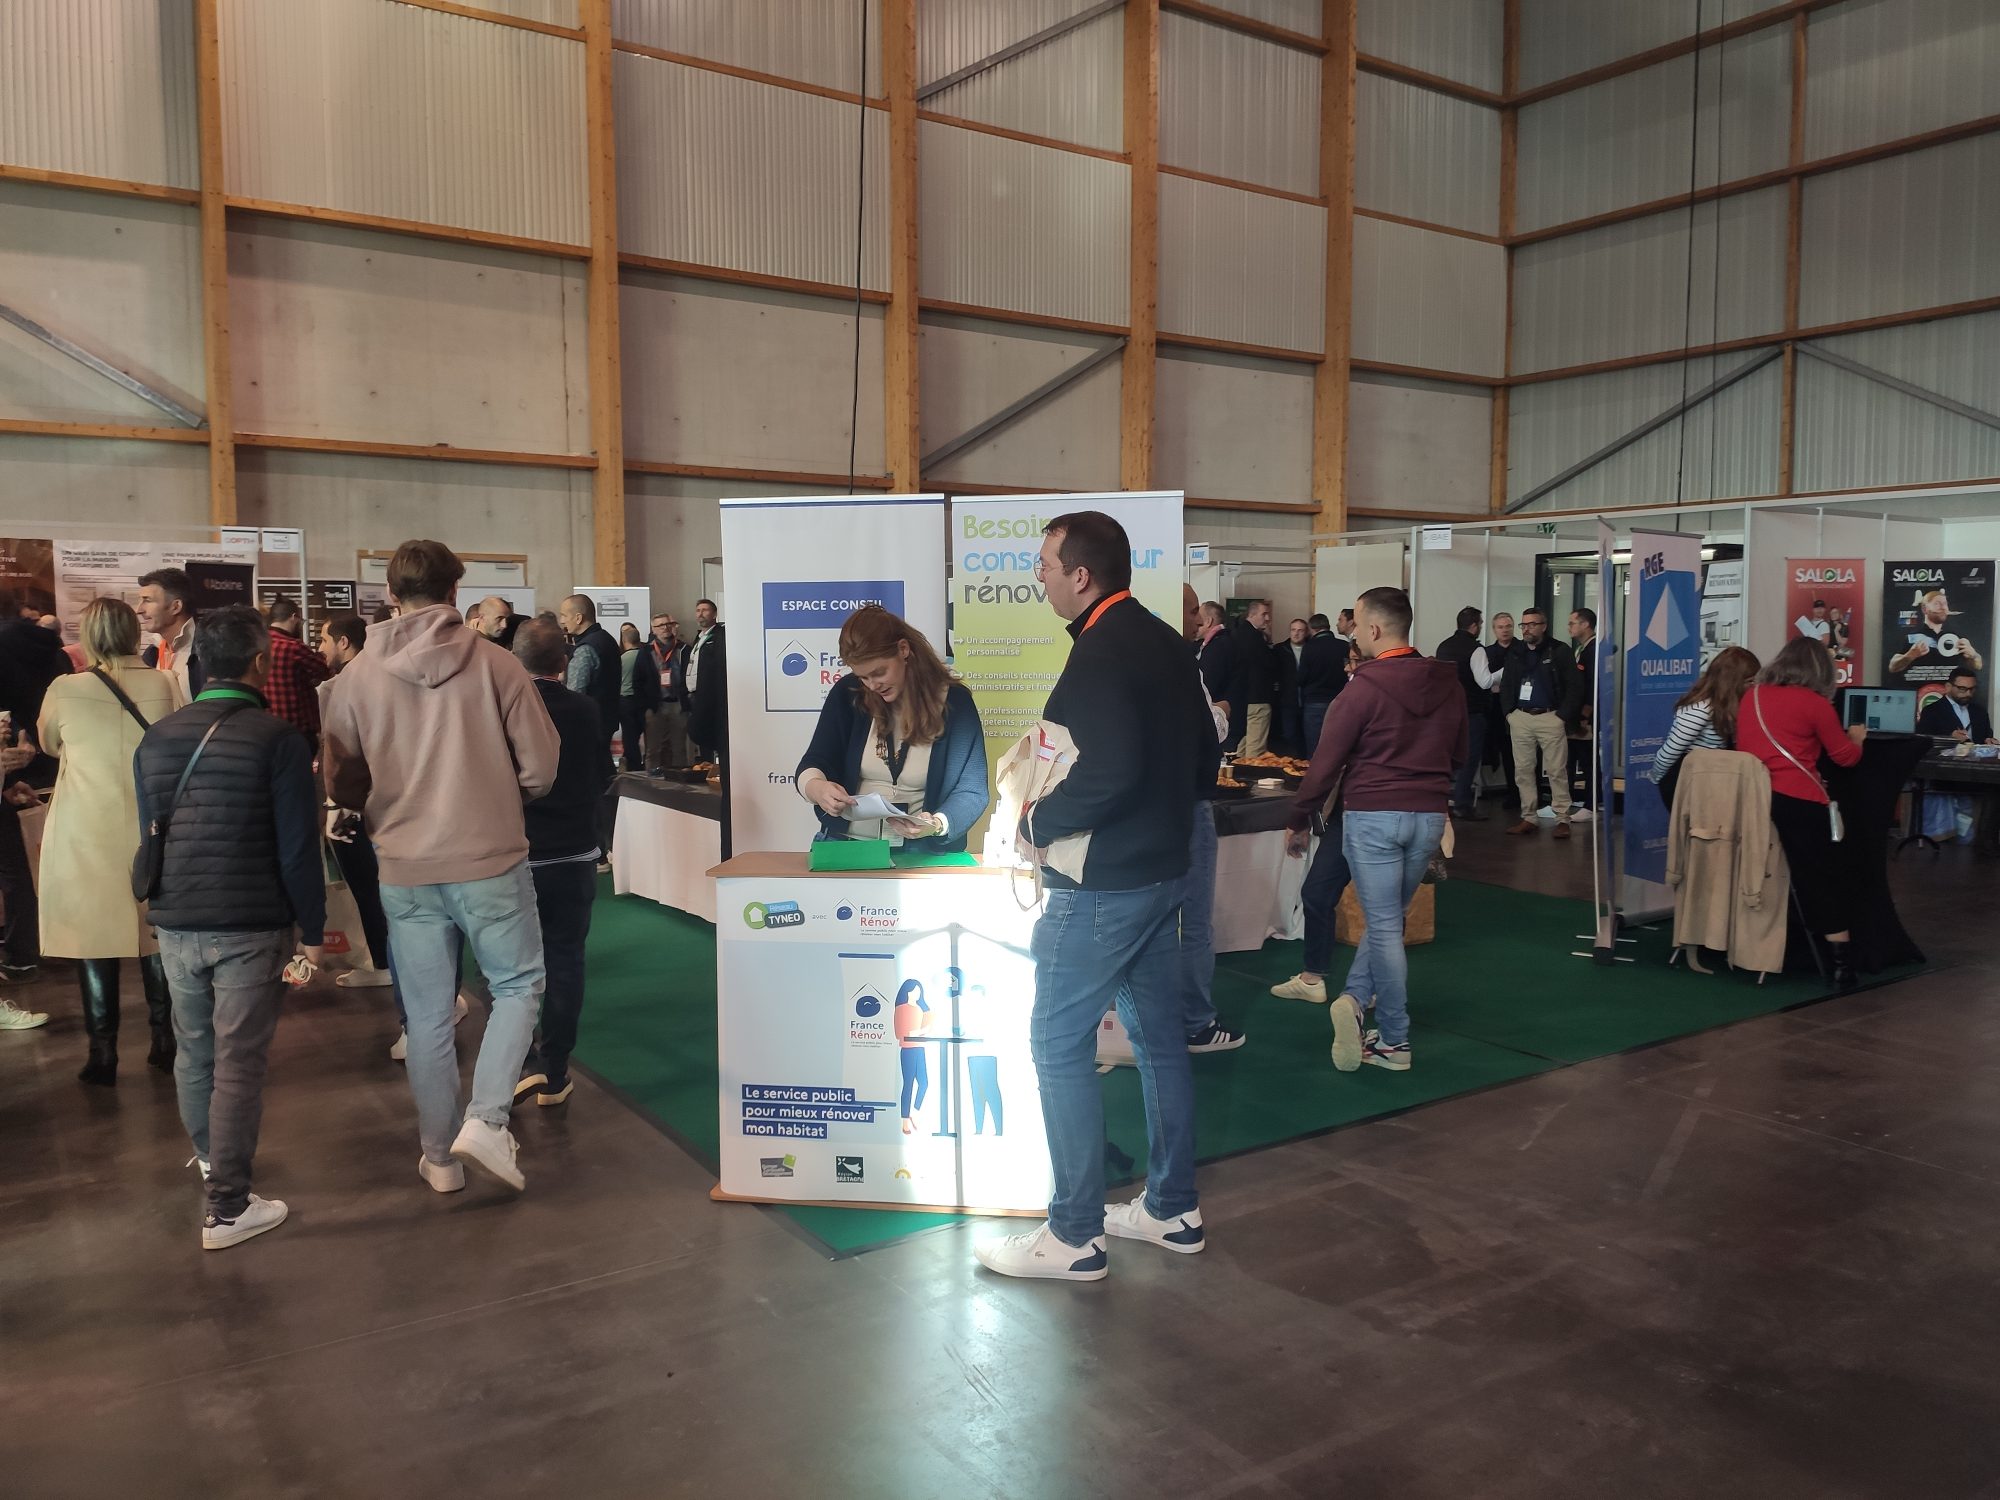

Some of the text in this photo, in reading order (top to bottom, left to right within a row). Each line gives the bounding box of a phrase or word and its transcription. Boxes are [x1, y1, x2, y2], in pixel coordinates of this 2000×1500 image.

[1644, 552, 1664, 578] RGE
[1795, 568, 1857, 583] SALOLA
[1892, 568, 1945, 582] SALOLA
[964, 576, 1048, 604] rénov
[782, 600, 827, 611] ESPACE
[966, 636, 1054, 646] Un accompagnement
[820, 652, 845, 667] Fra
[1641, 658, 1694, 676] QUALIBAT
[966, 671, 982, 679] Des
[984, 671, 1018, 679] conseils
[1026, 683, 1034, 691] et
[768, 772, 795, 784] fran
[860, 905, 898, 916] France
[768, 912, 801, 925] TYNEO
[860, 917, 900, 927] Rénov'
[850, 1020, 884, 1030] France
[850, 1030, 886, 1040] Rénov'
[745, 1087, 853, 1102] Le service public
[745, 1106, 872, 1121] pour mieux rénover
[745, 1123, 825, 1137] mon habitat
